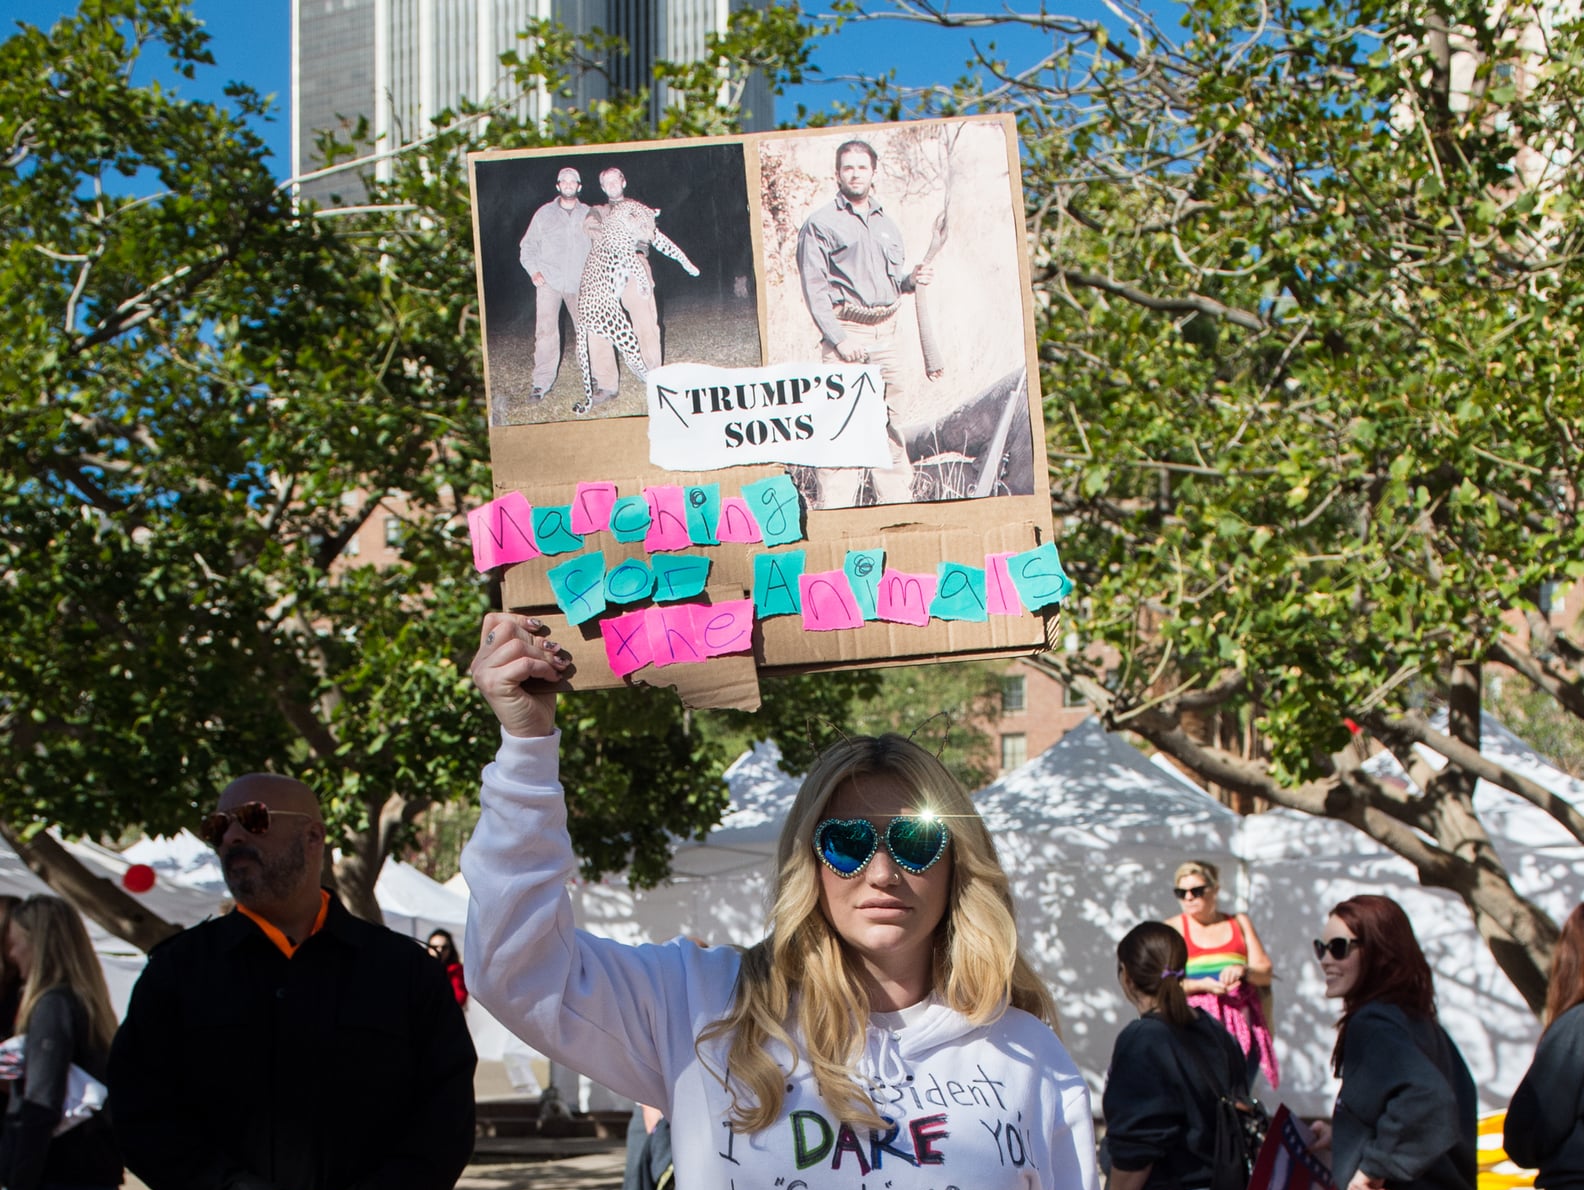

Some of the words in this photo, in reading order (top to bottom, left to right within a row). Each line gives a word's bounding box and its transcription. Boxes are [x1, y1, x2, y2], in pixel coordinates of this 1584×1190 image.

[685, 373, 847, 416] TRUMP'S
[724, 415, 815, 449] SONS
[476, 486, 796, 560] Marching
[564, 566, 711, 612] for
[767, 553, 1065, 620] Animals
[719, 1121, 741, 1166] I
[789, 1109, 950, 1176] DARE
